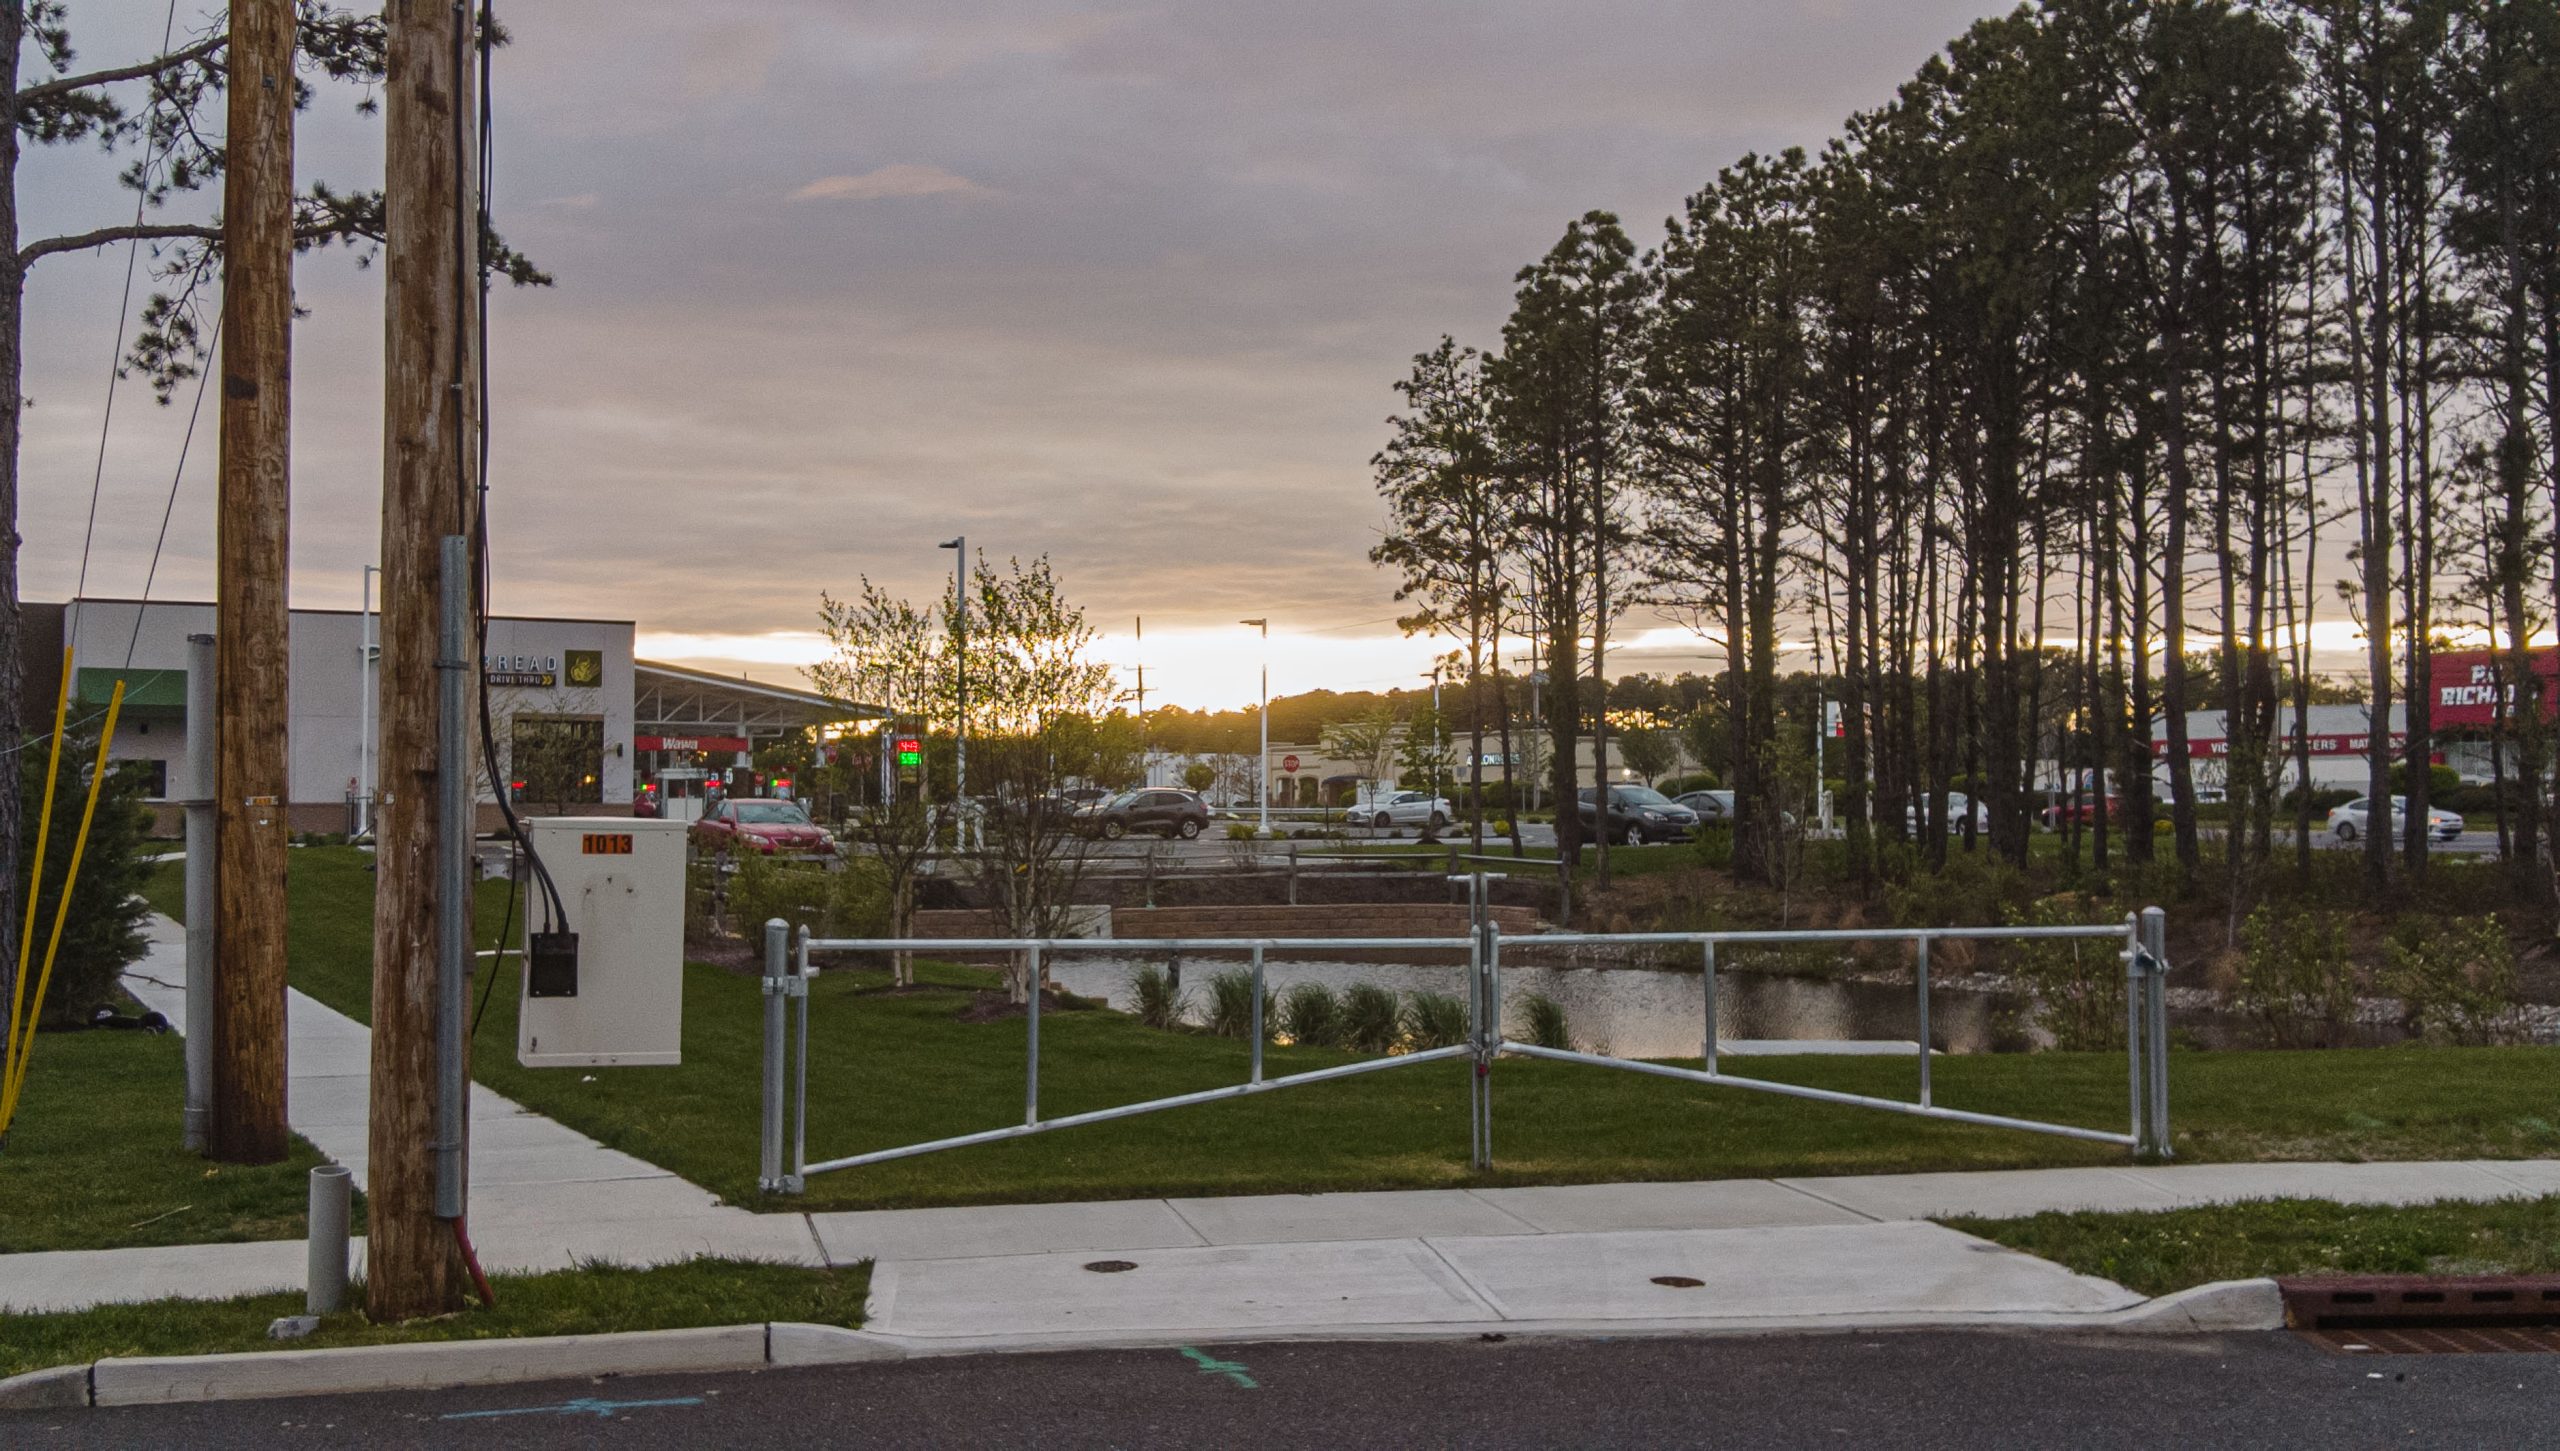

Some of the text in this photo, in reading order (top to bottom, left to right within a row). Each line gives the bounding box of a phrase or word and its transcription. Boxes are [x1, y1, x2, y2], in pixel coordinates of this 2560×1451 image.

[490, 674, 541, 685] DRIVE THRU
[662, 737, 699, 750] Wawa
[585, 834, 633, 854] 1013
